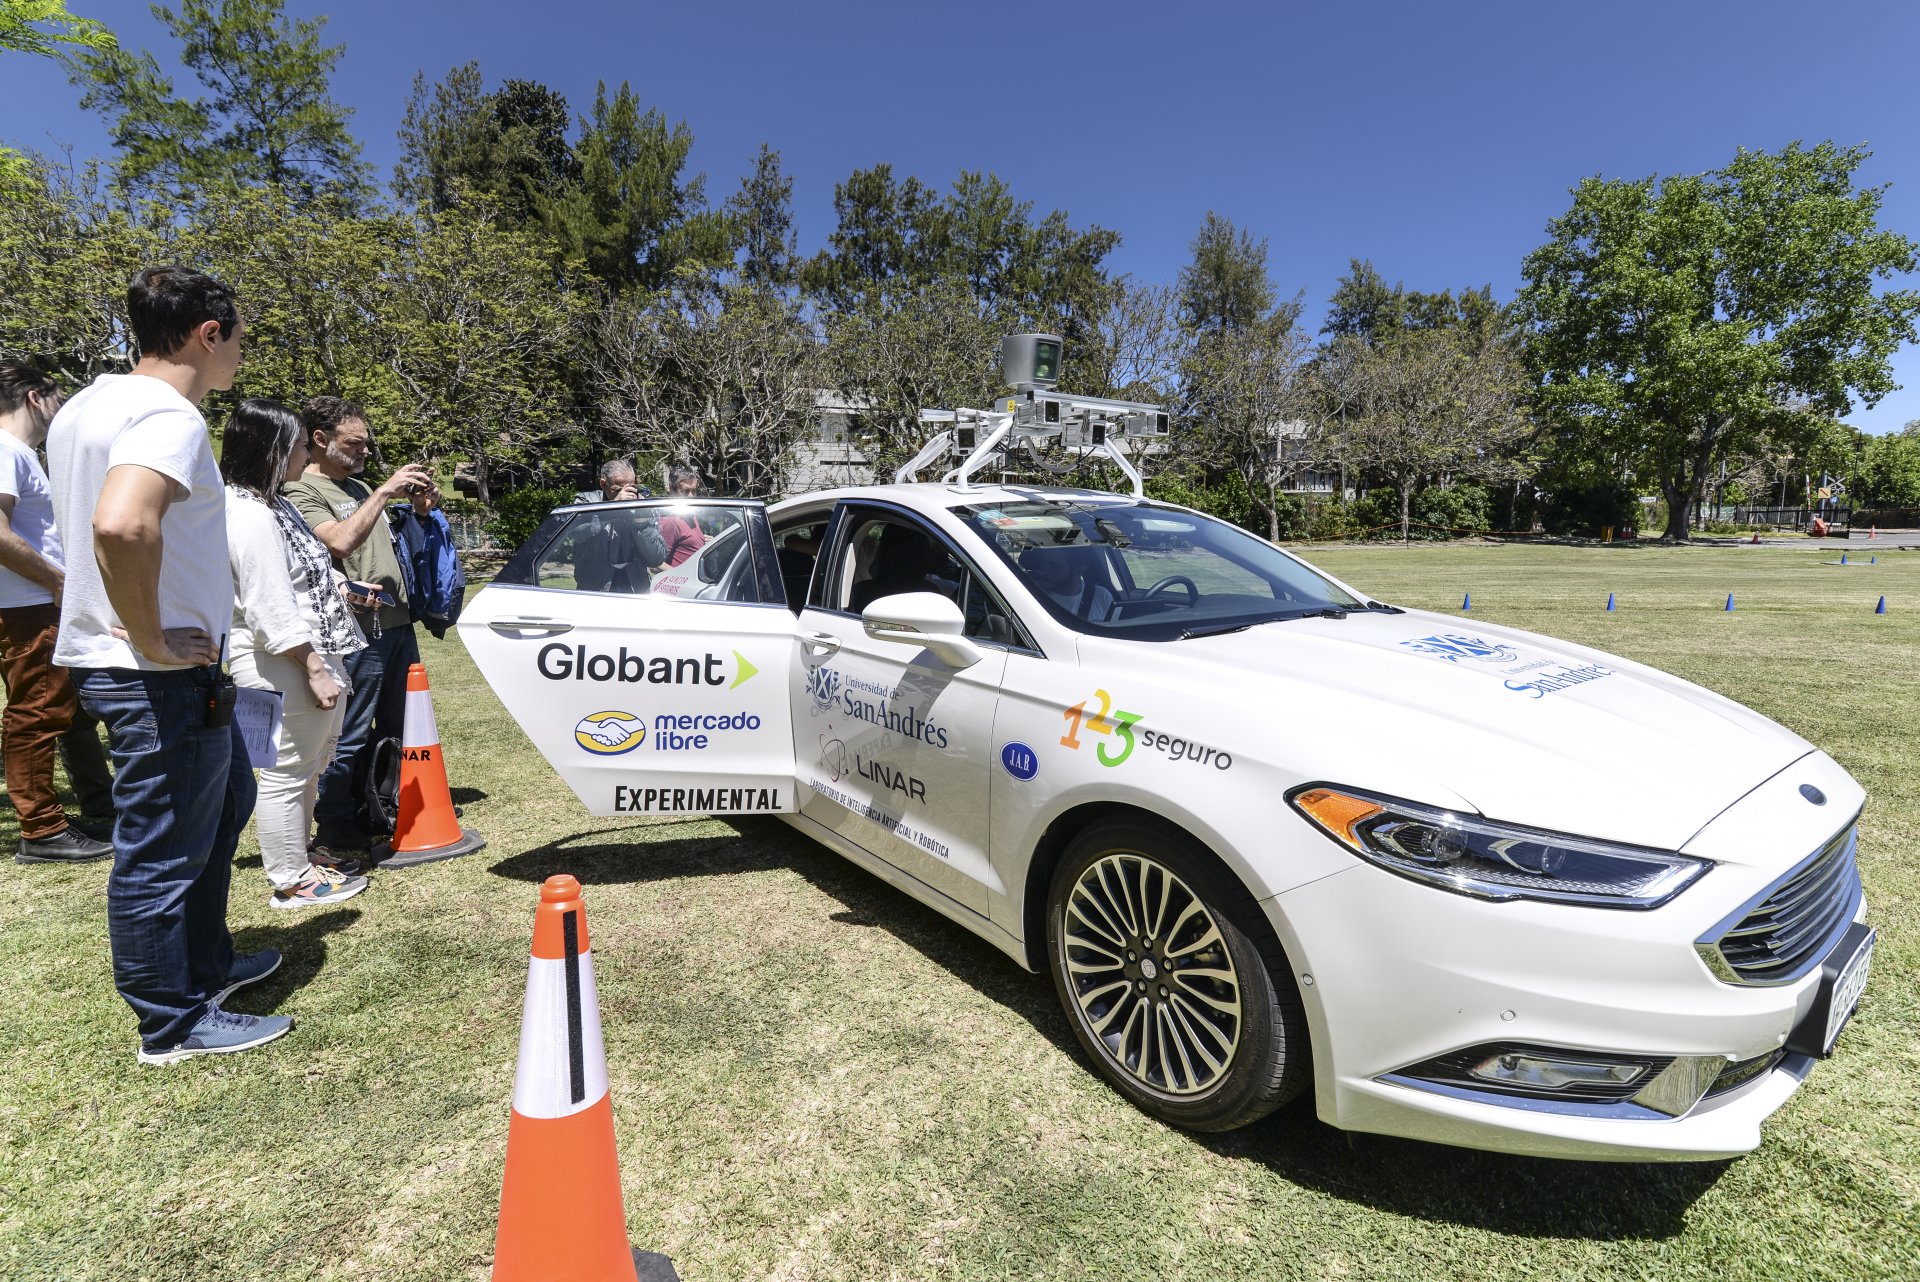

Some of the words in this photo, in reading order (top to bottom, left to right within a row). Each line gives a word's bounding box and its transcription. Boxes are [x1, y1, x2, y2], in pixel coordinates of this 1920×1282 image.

[336, 501, 357, 511] LOVE
[537, 643, 726, 686] Globant
[845, 674, 888, 698] Universidad
[889, 687, 900, 701] de
[655, 711, 761, 730] mercado
[844, 689, 948, 749] SanAndrés
[655, 731, 708, 751] libre
[1141, 729, 1233, 771] seguro
[401, 749, 431, 761] NAR
[857, 754, 926, 805] LINAR
[615, 785, 782, 812] EXPERIMENTAL
[810, 777, 840, 801] LABORATORIO
[840, 793, 847, 805] DE
[881, 813, 911, 840] ARTIFICIAL
[913, 831, 919, 842] Y
[918, 832, 949, 860] ROBÓTICA
